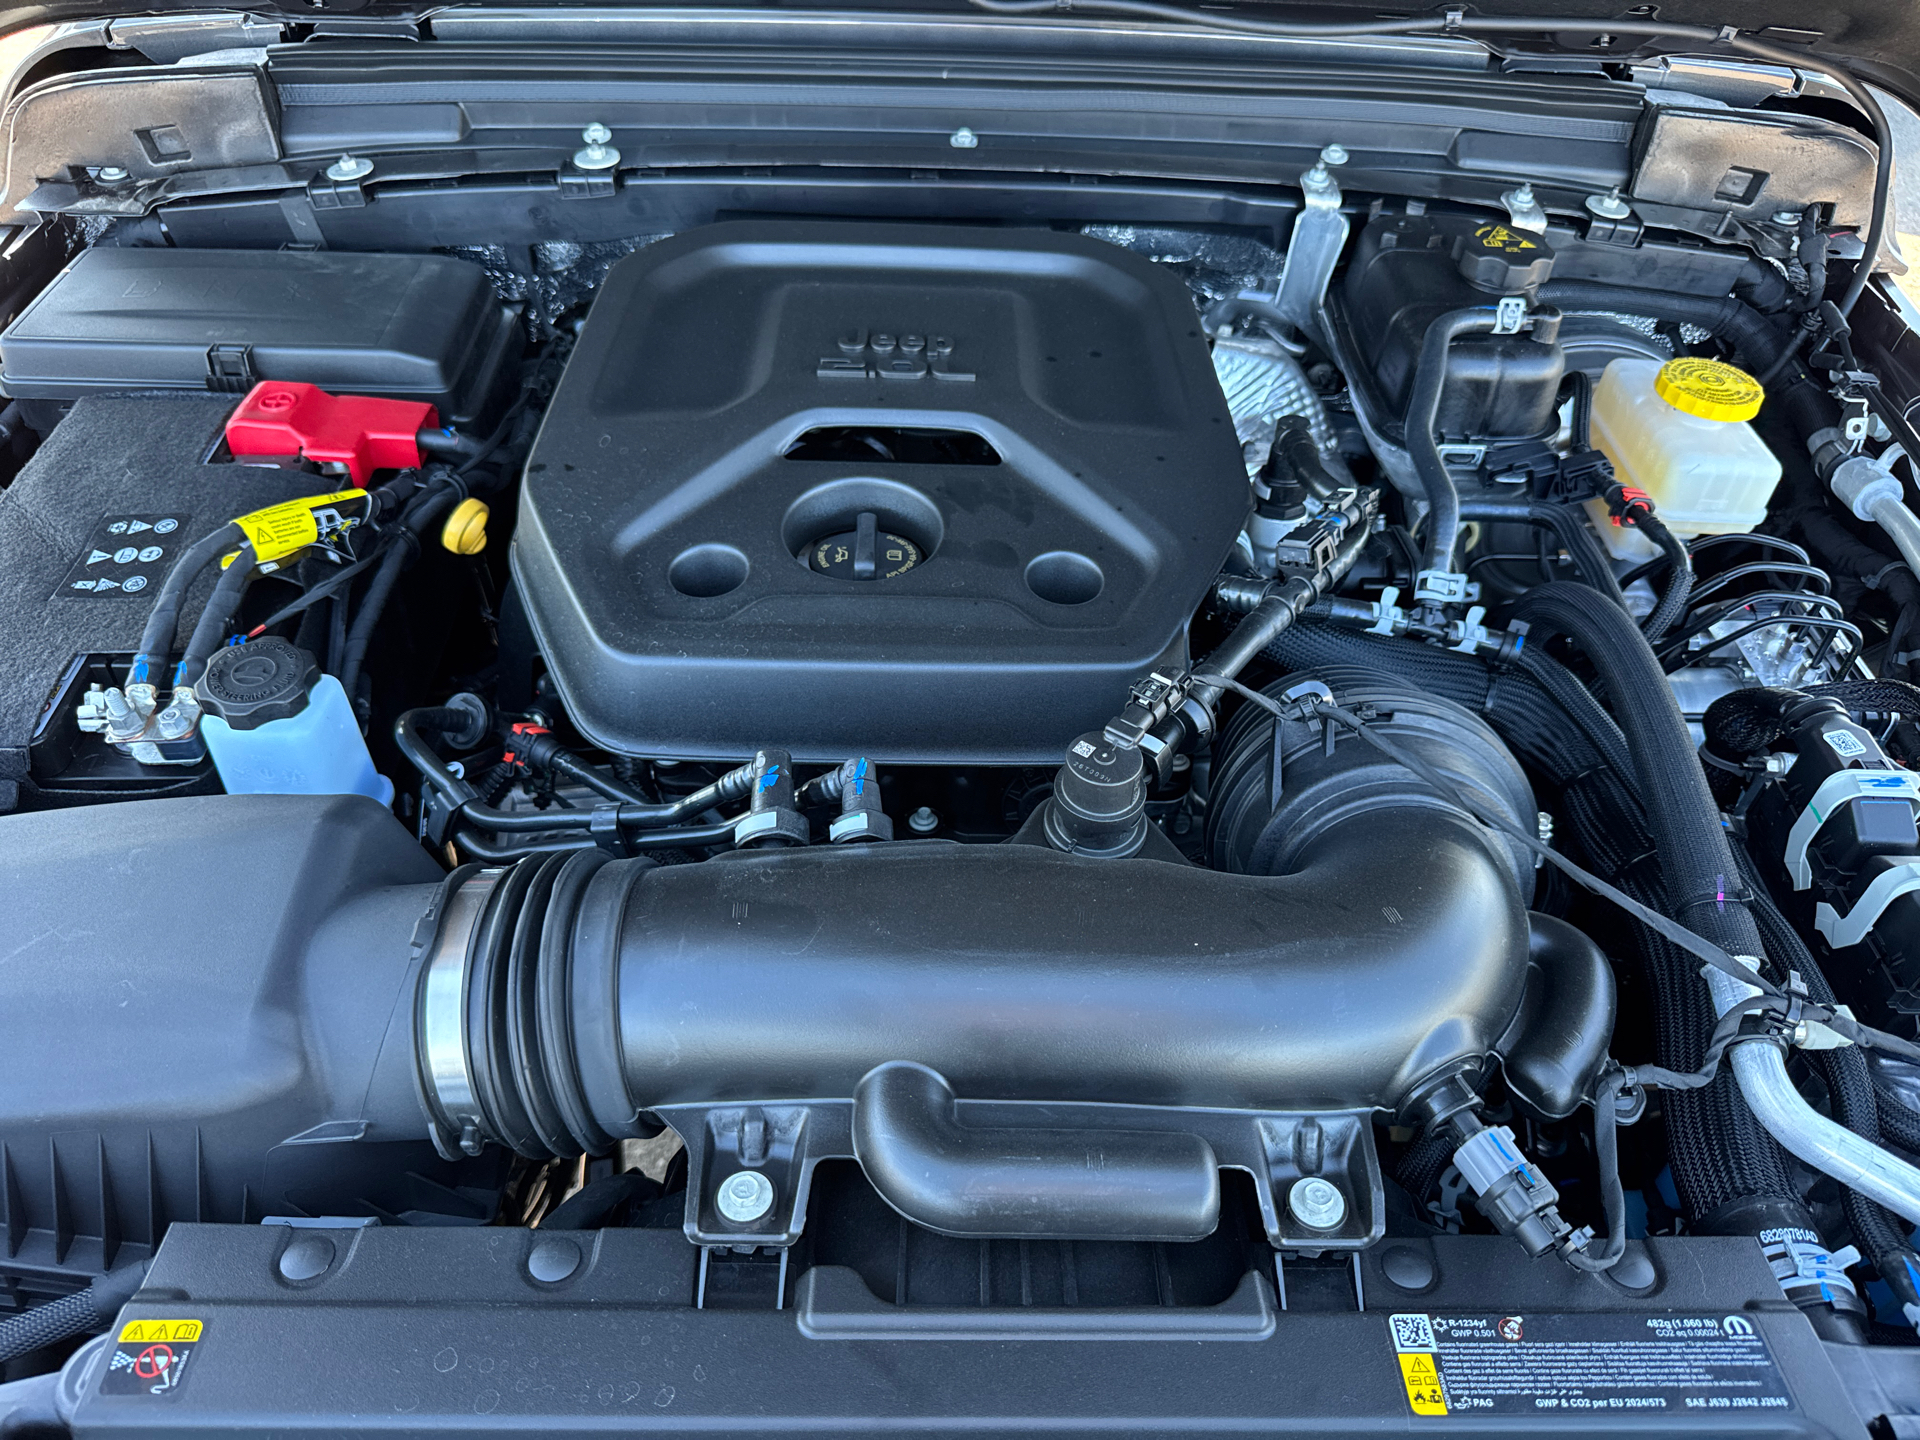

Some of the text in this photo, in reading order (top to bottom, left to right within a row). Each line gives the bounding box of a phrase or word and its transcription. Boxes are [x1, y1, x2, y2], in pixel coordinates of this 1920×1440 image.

[838, 328, 955, 359] Jeep
[816, 357, 976, 382] 2.0L
[817, 543, 832, 569] ENGINE OIL
[250, 642, 297, 660] APPROVED
[222, 689, 272, 702] STEERING
[272, 671, 296, 692] FLUID
[1646, 1318, 1719, 1330] 482g (1.060 lb)
[1656, 1328, 1676, 1338] CO2
[1686, 1328, 1719, 1338] 0.00024
[1451, 1329, 1496, 1338] GWP 0.501
[1473, 1399, 1494, 1408] PAG
[1535, 1398, 1559, 1408] GWP
[1560, 1399, 1568, 1408] &
[1570, 1398, 1591, 1408] CO2
[1609, 1398, 1624, 1407] EU
[1624, 1398, 1666, 1407] 2024/573
[1685, 1398, 1707, 1407] SAE
